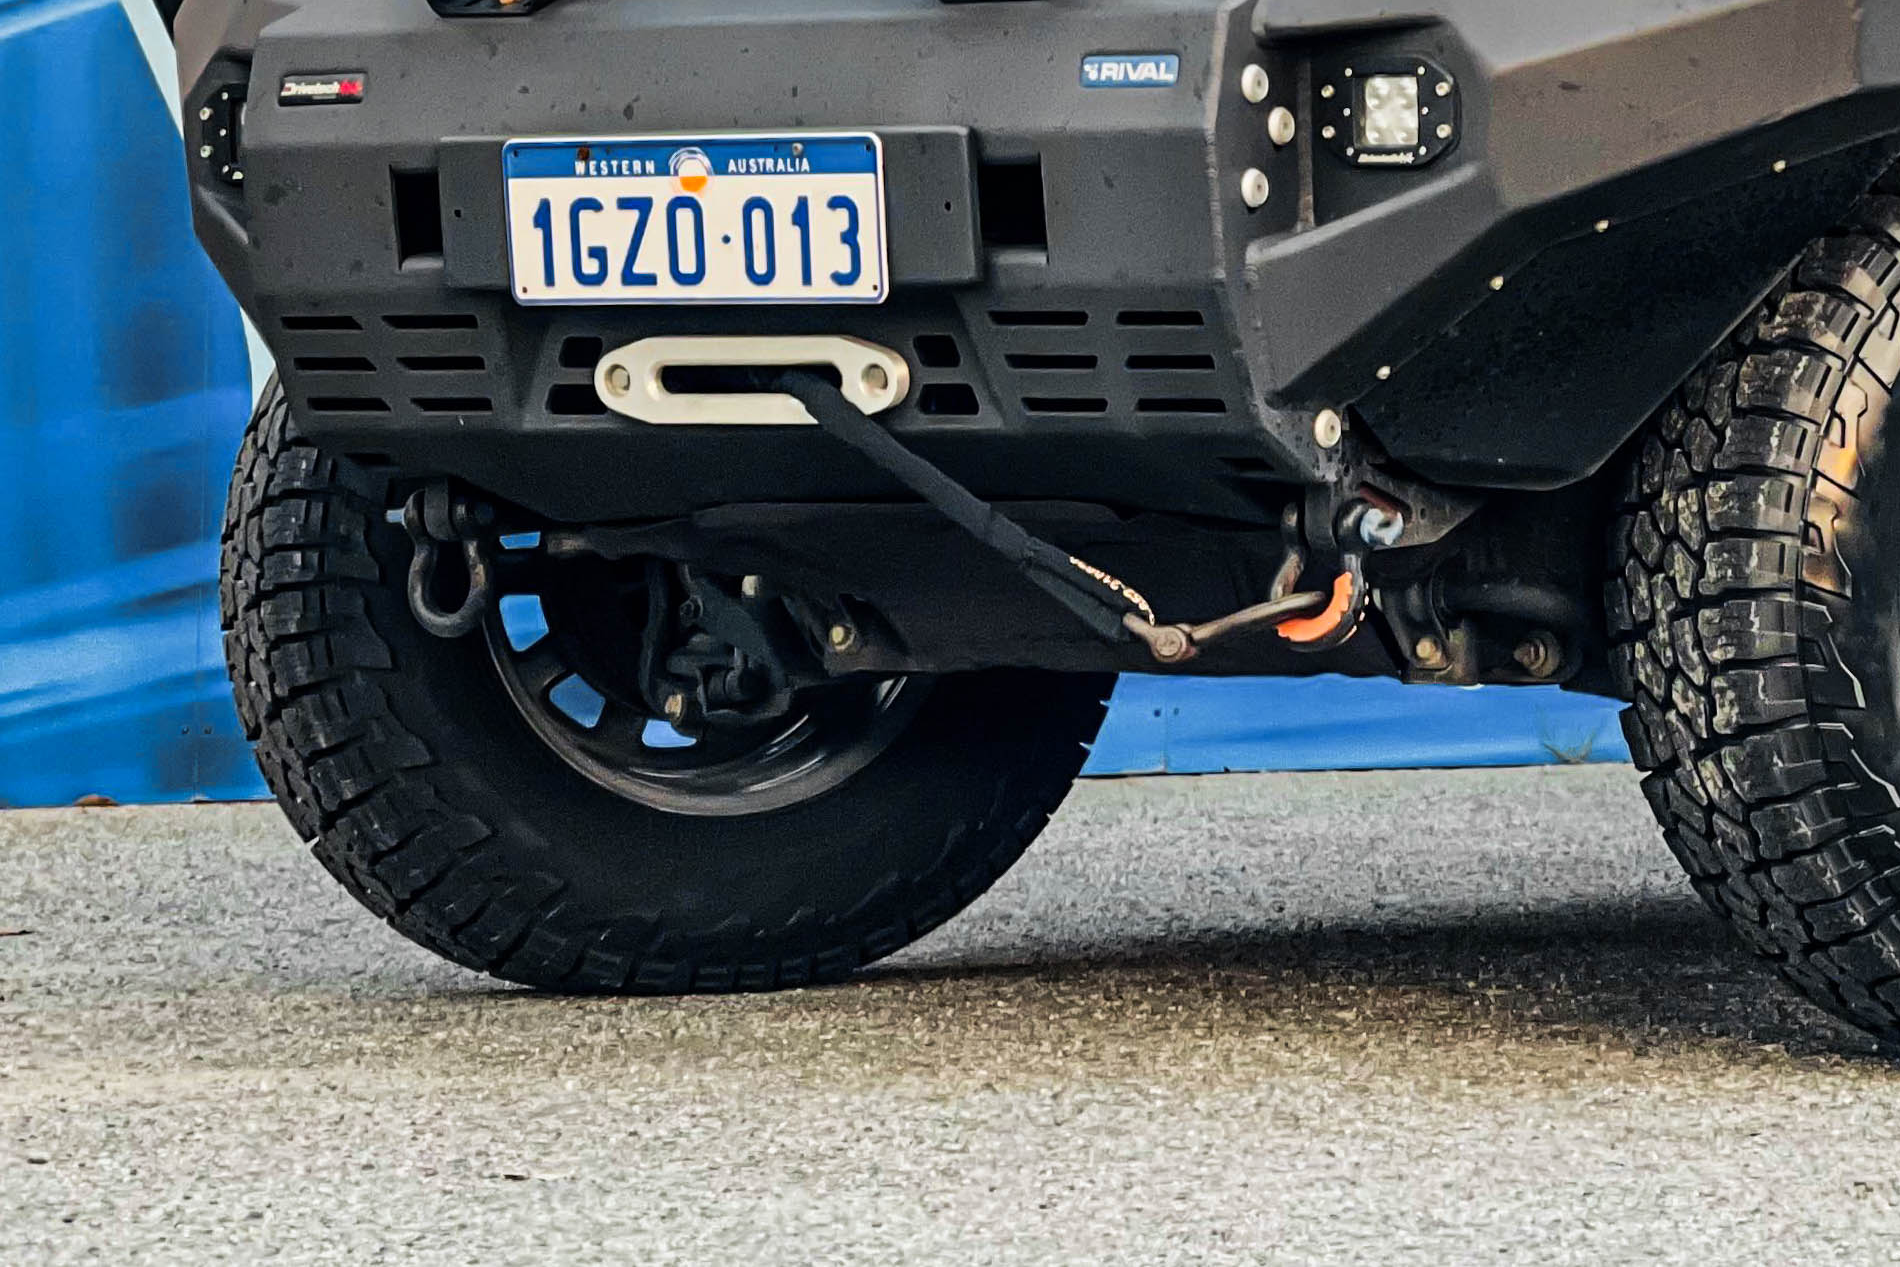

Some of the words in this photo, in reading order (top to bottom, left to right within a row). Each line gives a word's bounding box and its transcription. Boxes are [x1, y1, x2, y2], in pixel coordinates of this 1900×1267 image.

[1100, 61, 1174, 81] RIVAL
[574, 160, 656, 176] WESTERN
[728, 157, 811, 174] AUSTRALIA
